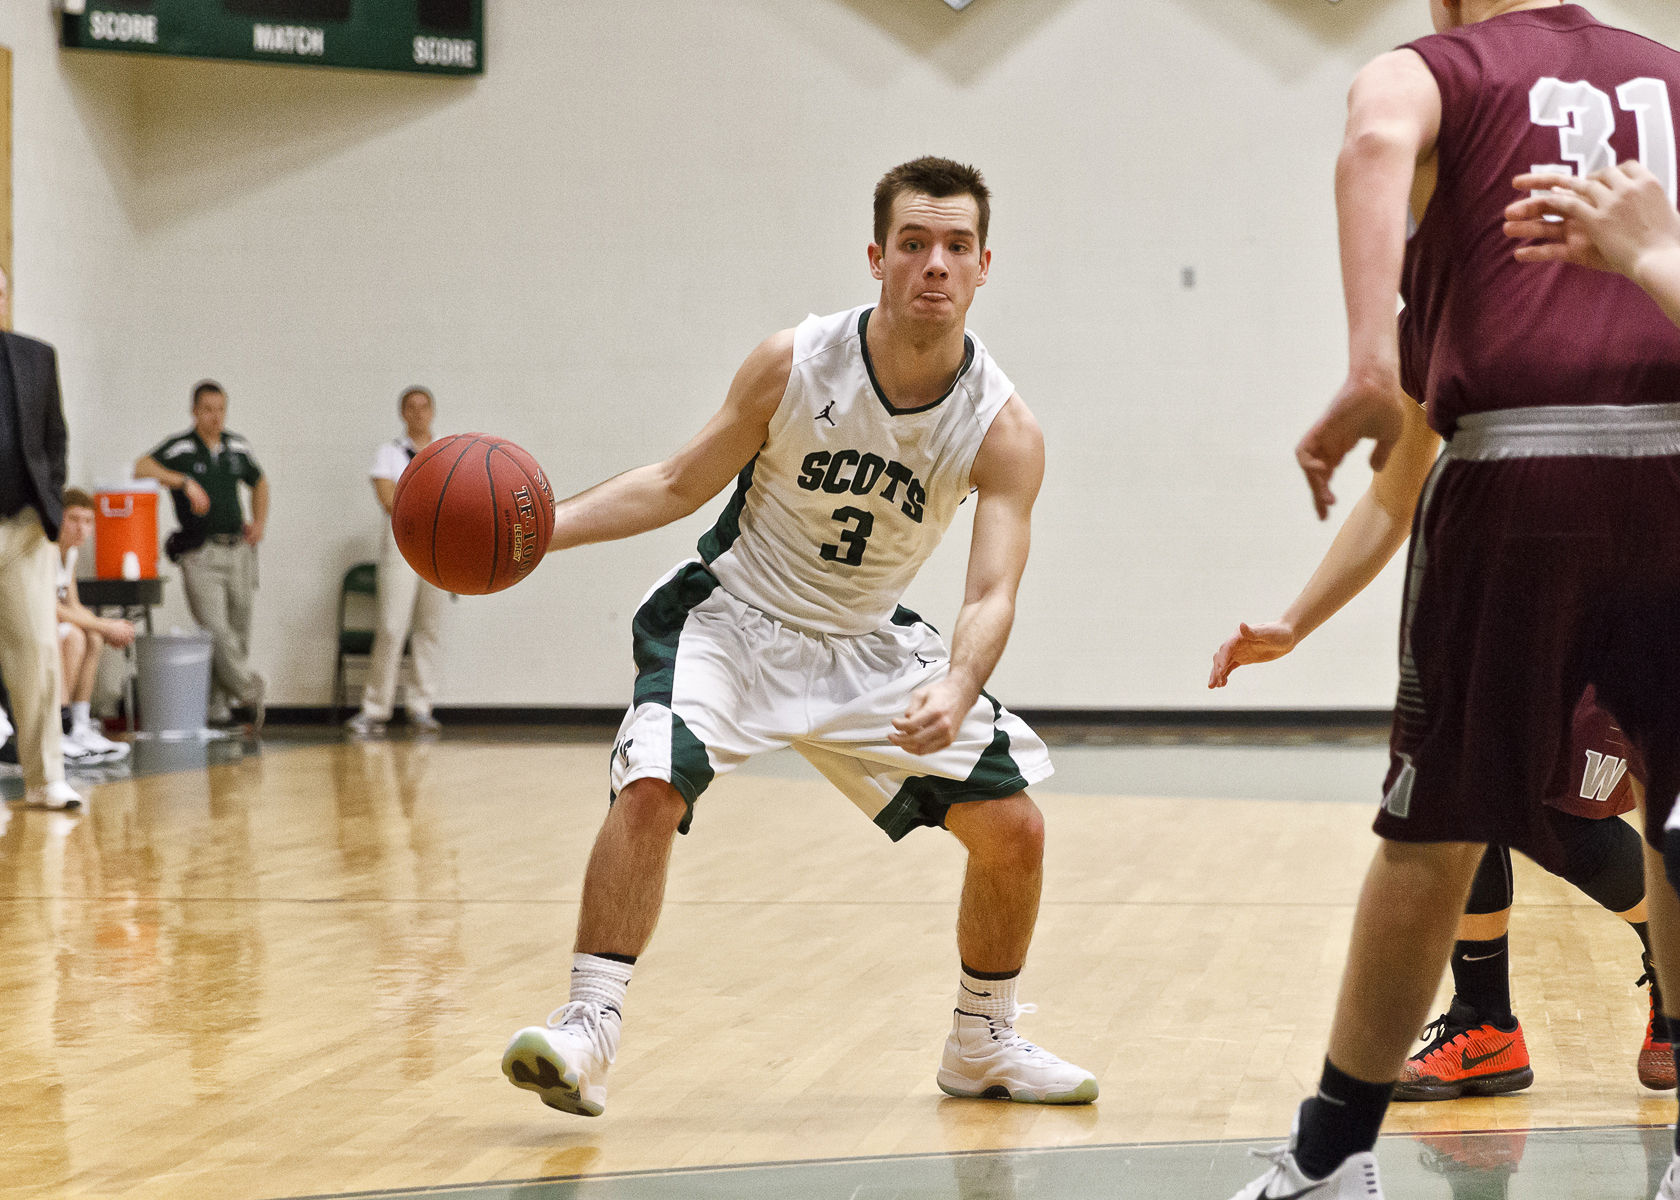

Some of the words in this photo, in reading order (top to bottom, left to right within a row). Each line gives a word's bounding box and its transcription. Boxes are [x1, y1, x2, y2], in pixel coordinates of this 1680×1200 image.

[90, 10, 158, 44] SCORE
[253, 24, 324, 56] MATCH
[413, 36, 477, 68] SCORE
[1529, 77, 1678, 222] 31
[797, 449, 926, 524] SCOTS
[513, 524, 522, 562] LEGACY
[819, 505, 875, 567] 3
[1579, 749, 1628, 801] W
